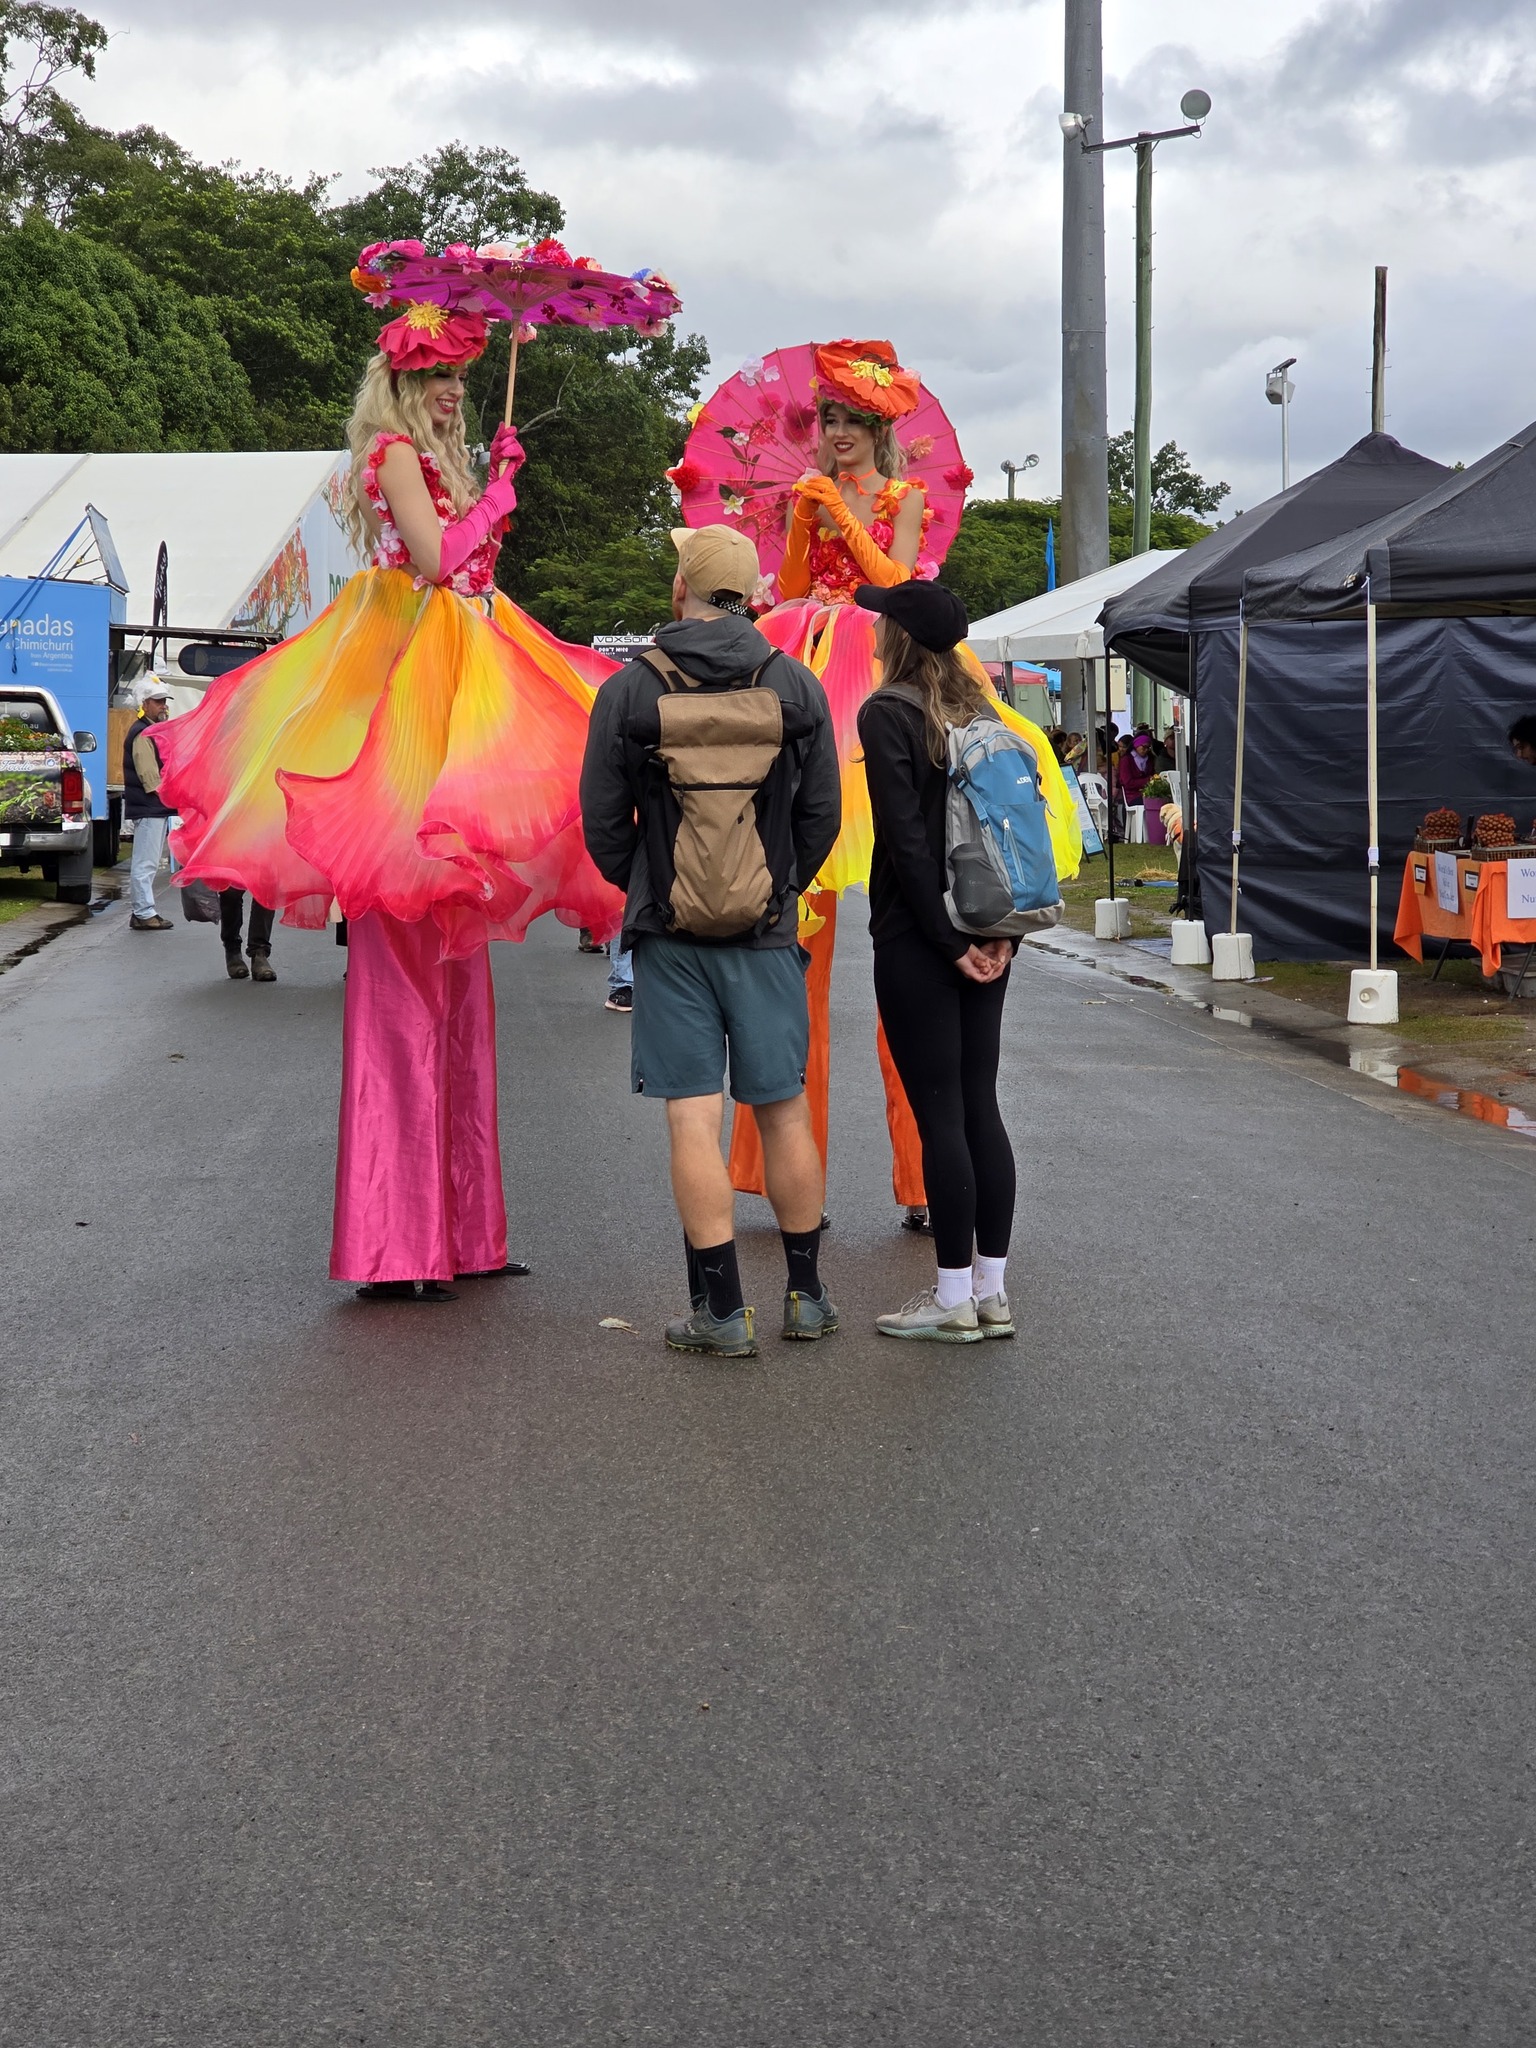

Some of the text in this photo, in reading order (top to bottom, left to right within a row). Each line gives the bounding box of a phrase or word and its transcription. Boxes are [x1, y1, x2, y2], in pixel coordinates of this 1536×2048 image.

[5, 637, 74, 651] & Chimichurri
[42, 651, 74, 661] Argentina
[209, 653, 256, 666] empana
